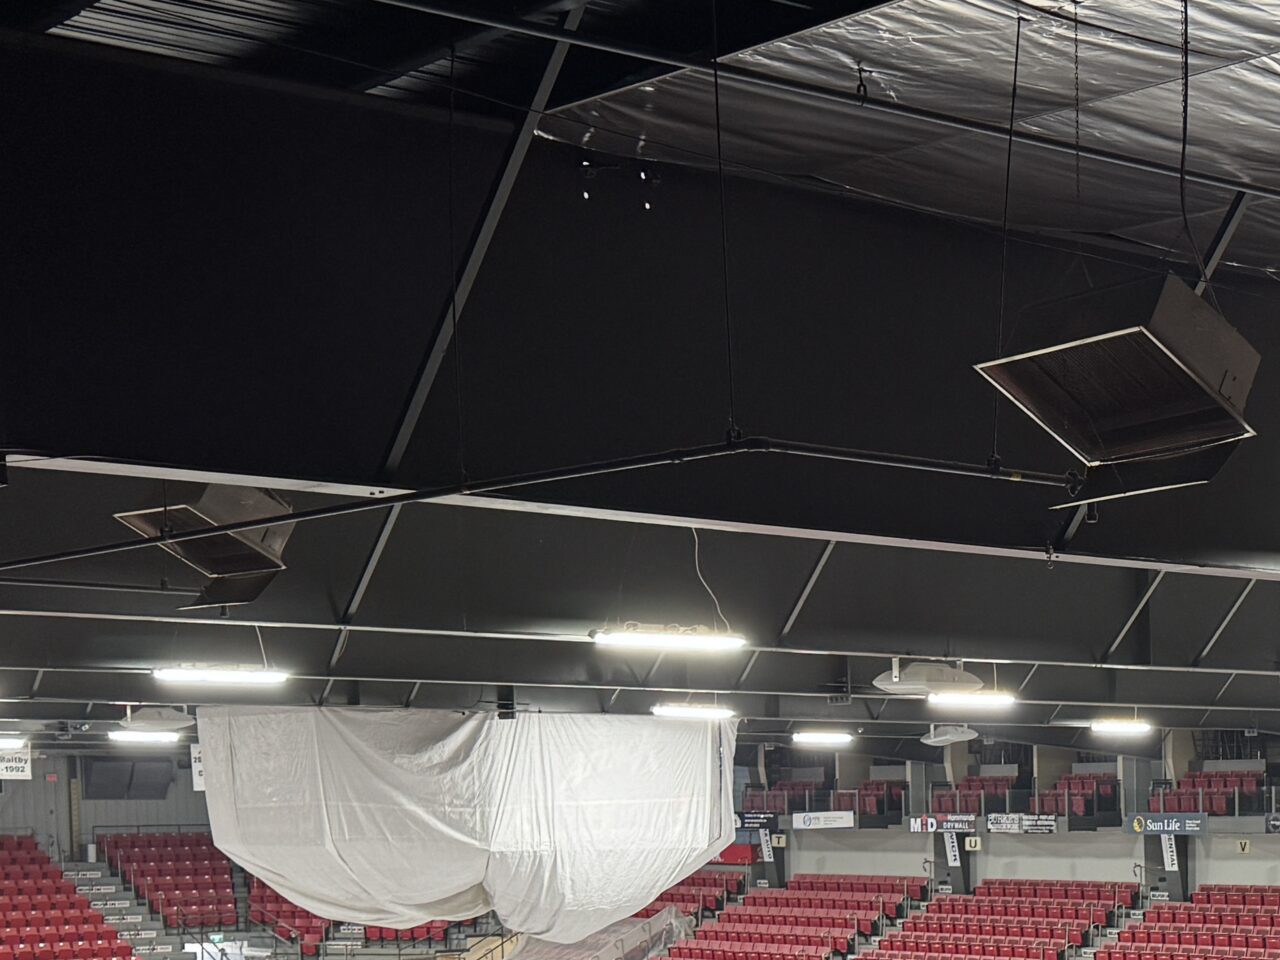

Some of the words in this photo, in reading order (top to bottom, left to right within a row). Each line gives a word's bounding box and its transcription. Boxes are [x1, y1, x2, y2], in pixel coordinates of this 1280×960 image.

[1146, 819, 1164, 831] Sun
[1164, 818, 1181, 831] Life
[775, 835, 784, 845] T
[968, 839, 978, 849] U
[1239, 841, 1247, 852] V
